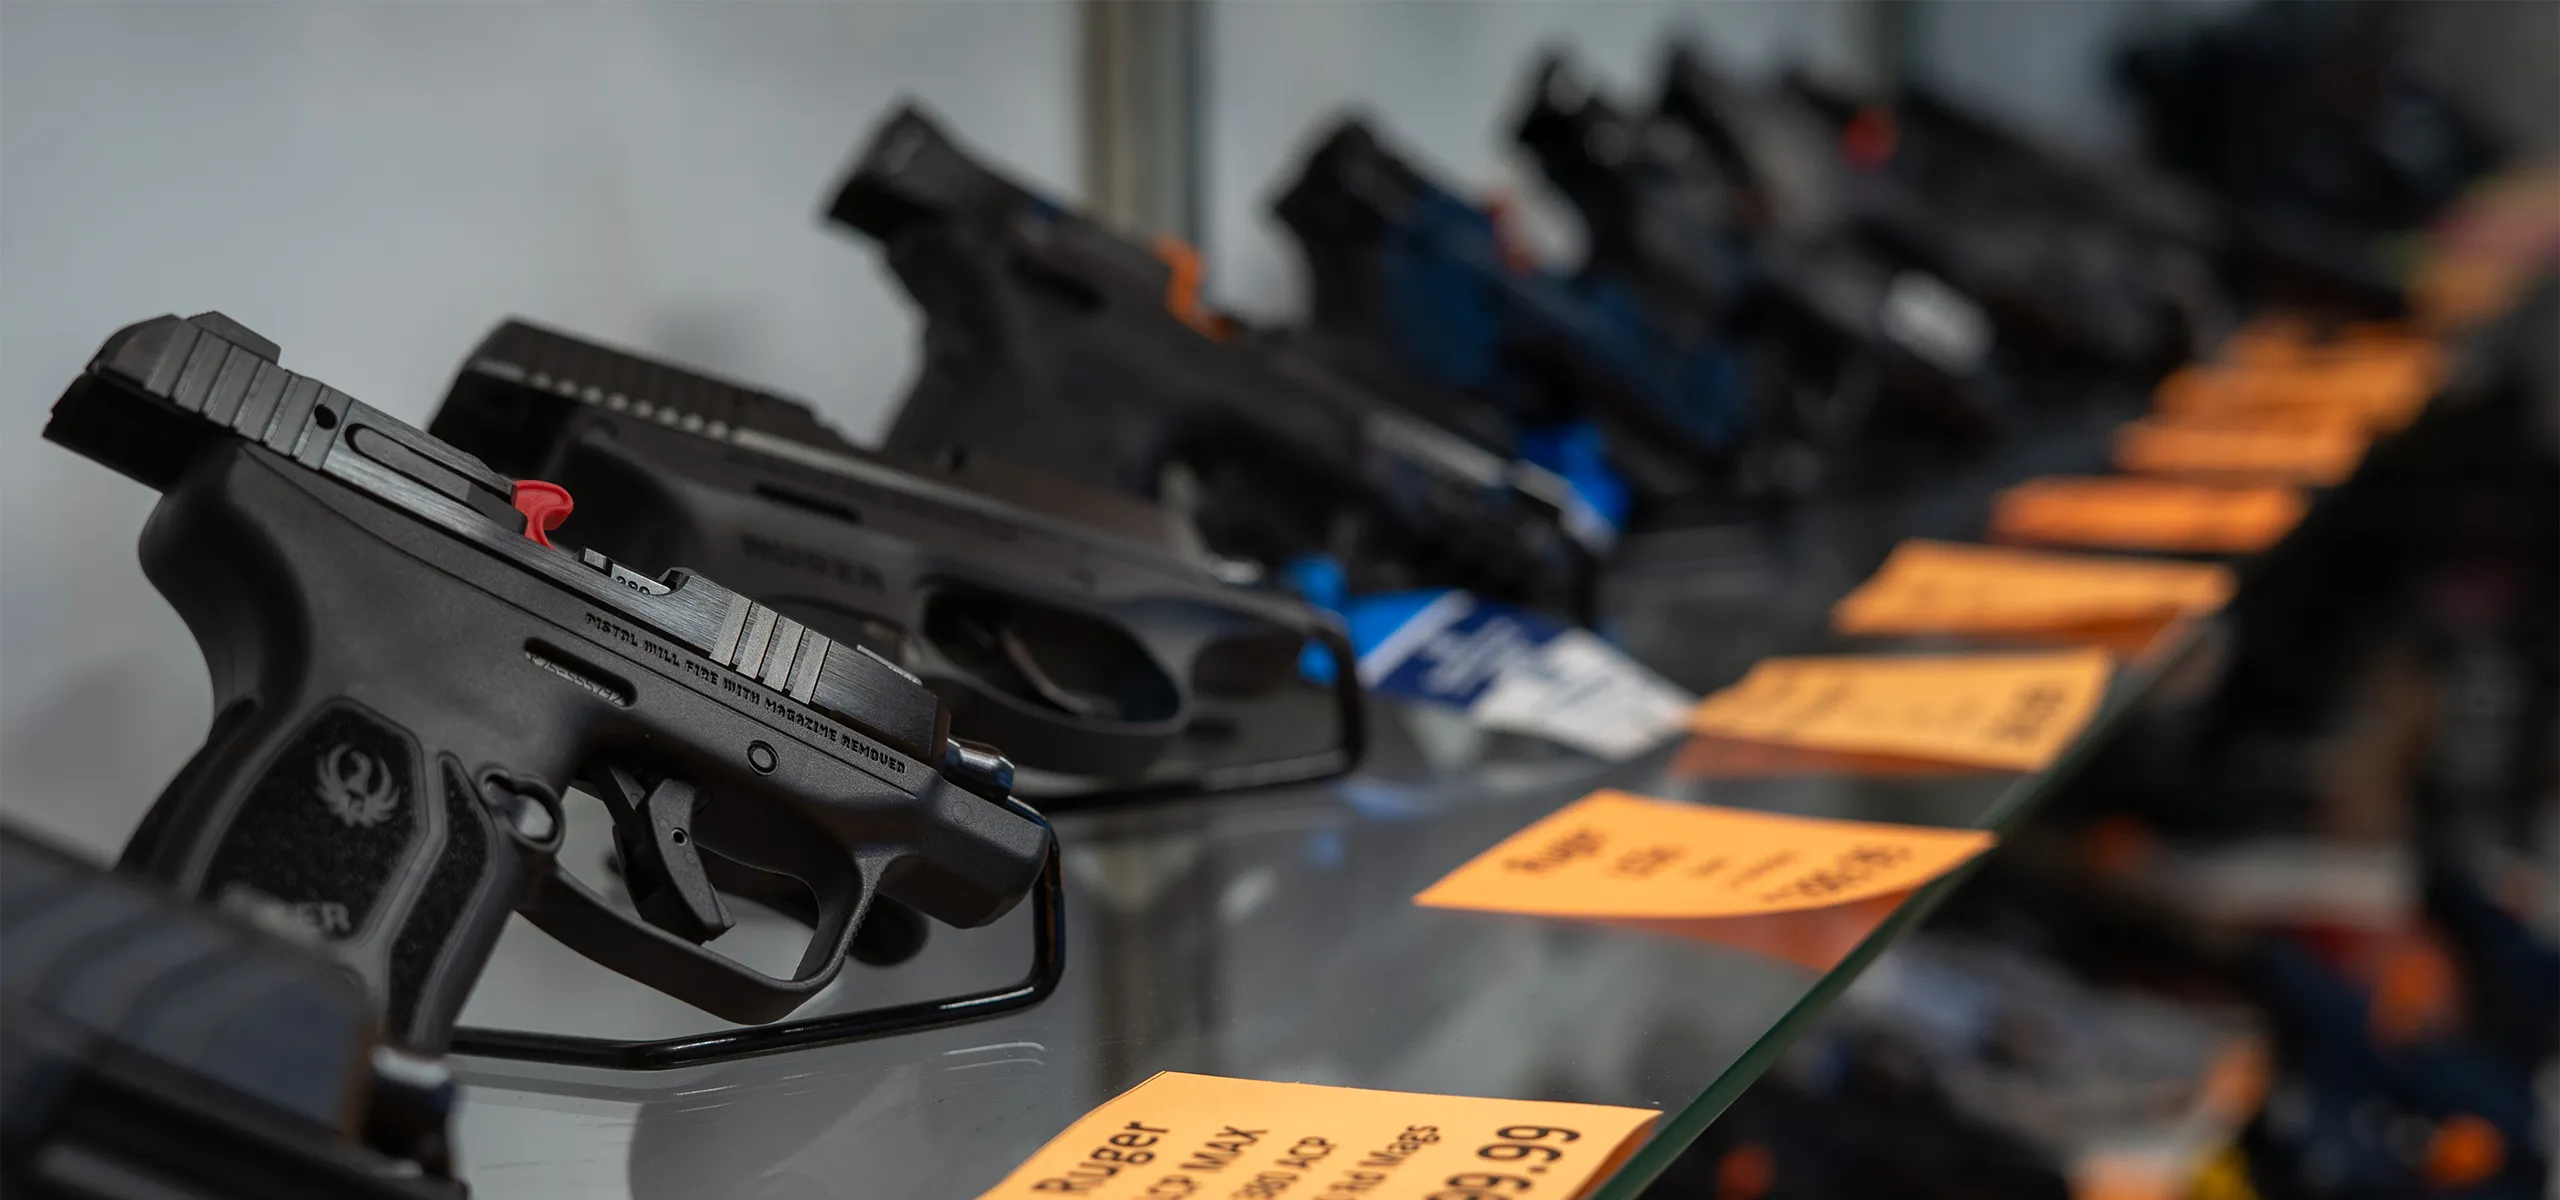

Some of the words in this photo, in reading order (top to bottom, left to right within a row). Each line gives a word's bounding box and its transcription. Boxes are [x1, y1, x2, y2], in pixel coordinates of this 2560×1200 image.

[586, 612, 638, 647] PISTOL
[644, 639, 680, 667] WILL
[685, 659, 719, 685] FIRE
[723, 678, 760, 705] WITH
[765, 698, 837, 742] MAGAZINE
[841, 734, 906, 774] REMOVED
[1031, 1121, 1169, 1196] Ruger
[1179, 1125, 1268, 1172] MAX
[1274, 1136, 1337, 1170] ACP
[1357, 1125, 1440, 1169] Mags
